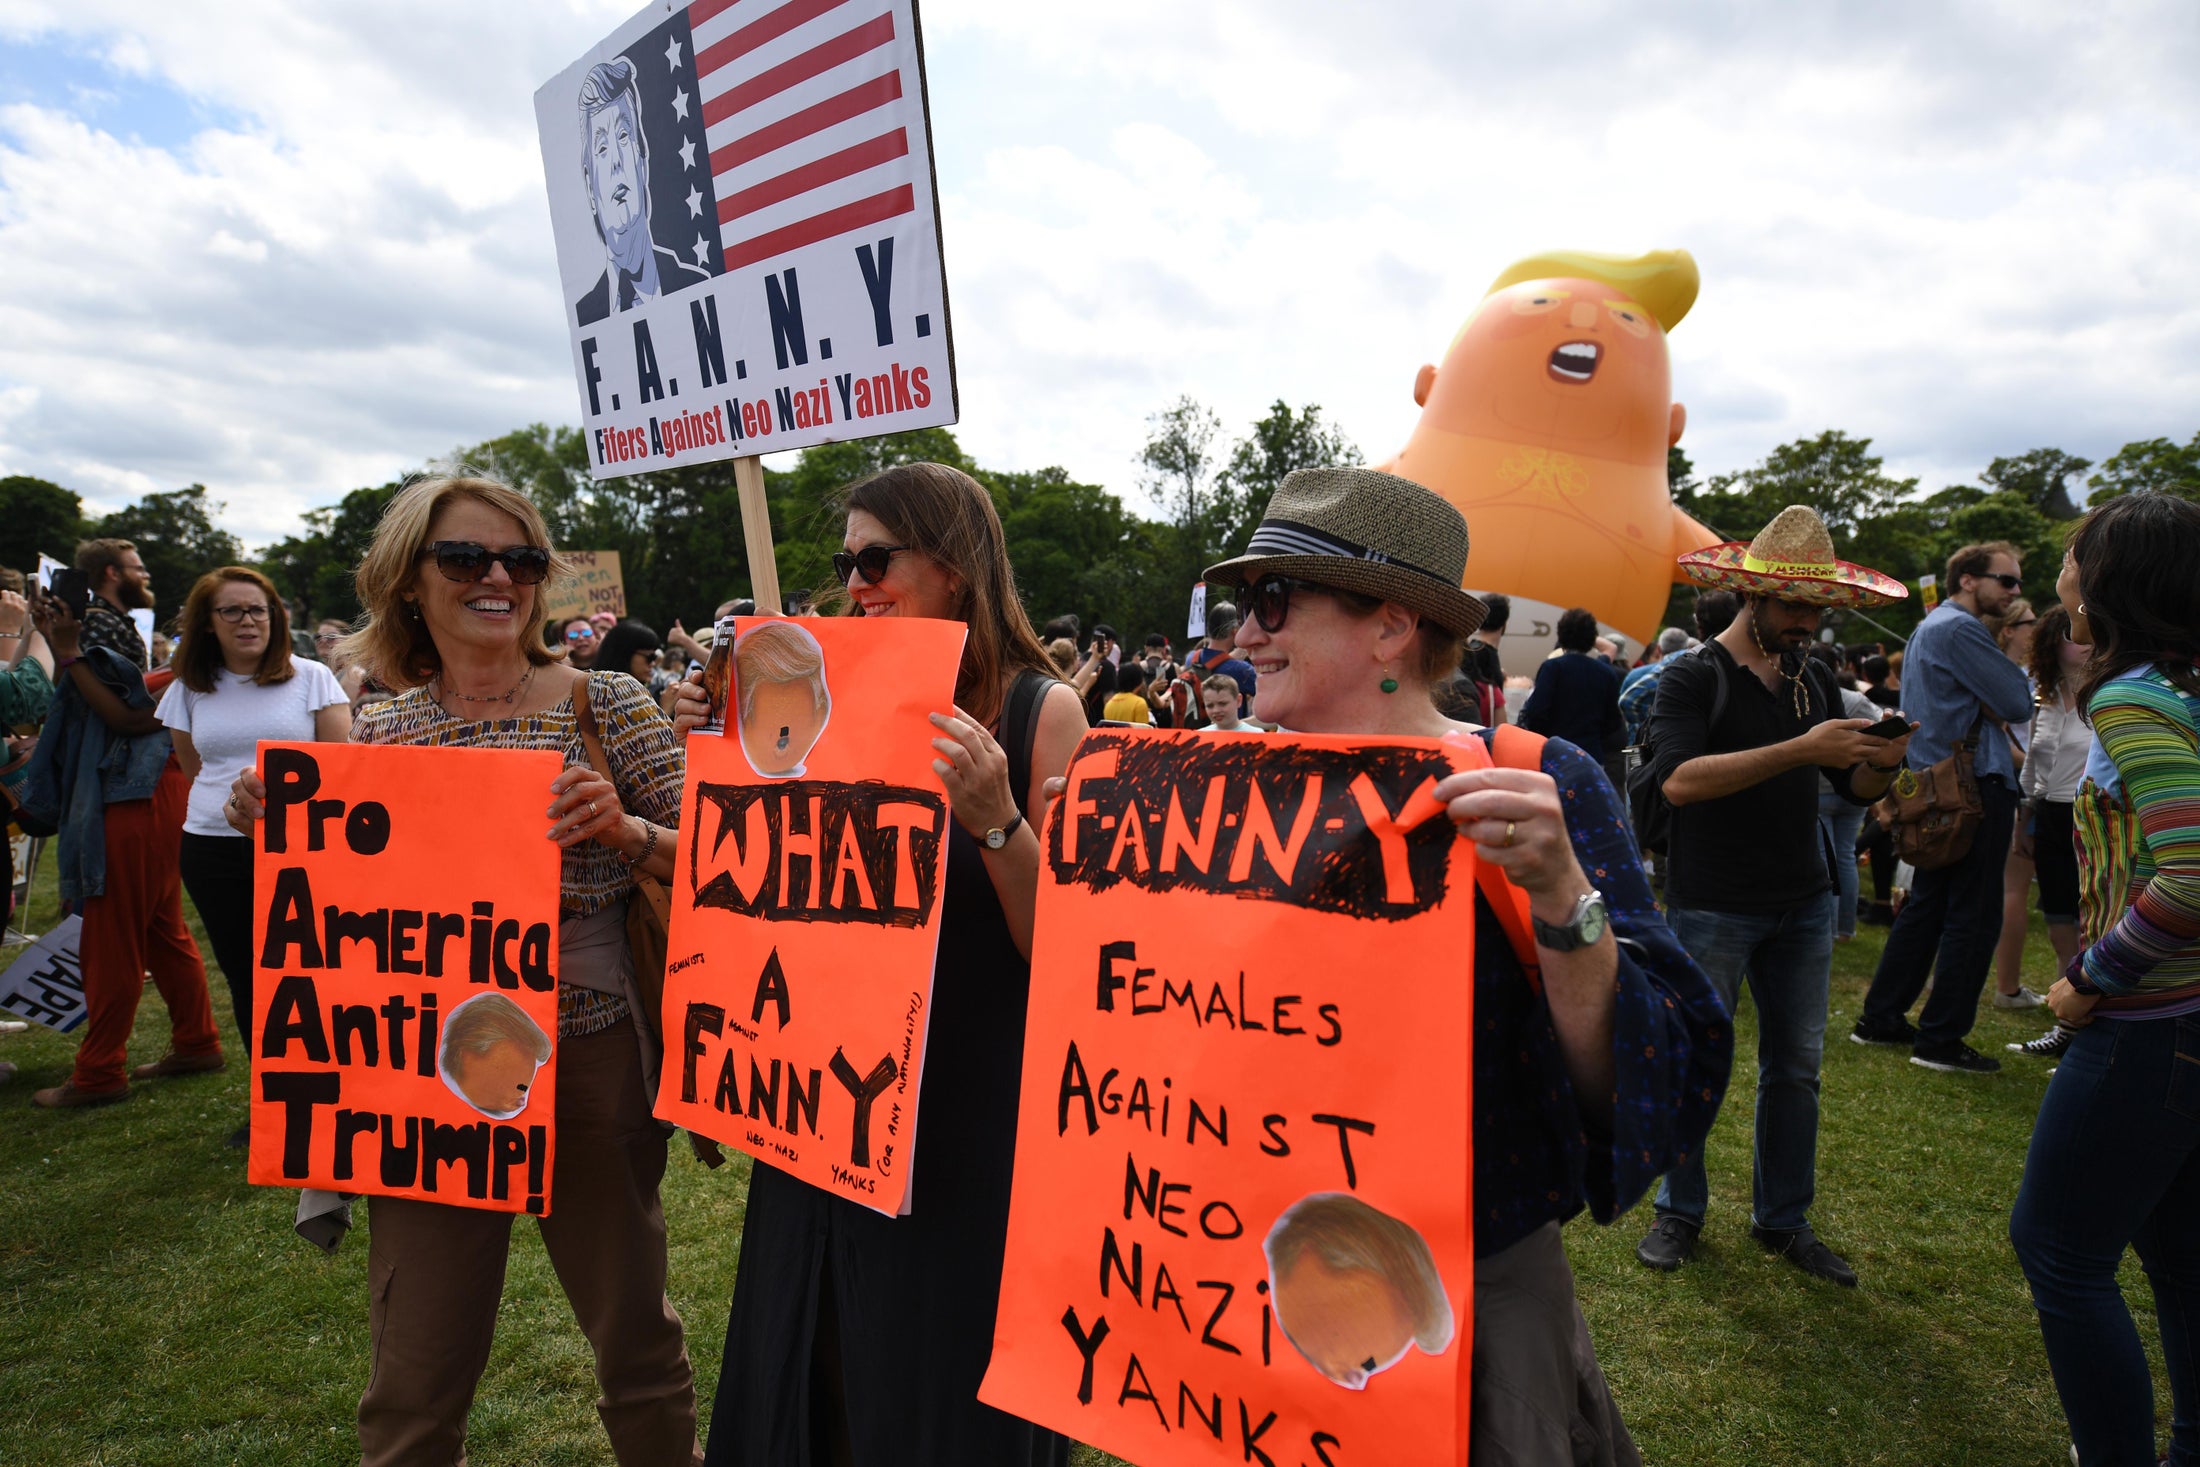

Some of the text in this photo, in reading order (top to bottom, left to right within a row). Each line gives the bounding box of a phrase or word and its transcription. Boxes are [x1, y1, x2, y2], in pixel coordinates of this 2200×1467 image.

[595, 363, 931, 465] Fifers Against Neo Nazi Yanks
[589, 585, 619, 602] NOT
[264, 748, 391, 856] Pro
[697, 794, 936, 911] WHAT
[0, 947, 84, 1027] APE
[669, 953, 705, 976] FEMINISTS
[751, 945, 791, 1033] A
[1096, 941, 1342, 1047] FEMALES
[261, 976, 438, 1078] Anti
[729, 1018, 759, 1043] AGAINST
[831, 1164, 876, 1194] YANKS
[877, 1146, 894, 1177] (OR
[888, 1103, 901, 1136] ANY
[1124, 1152, 1244, 1239] NEO
[1061, 1305, 1341, 1467] YANKS
